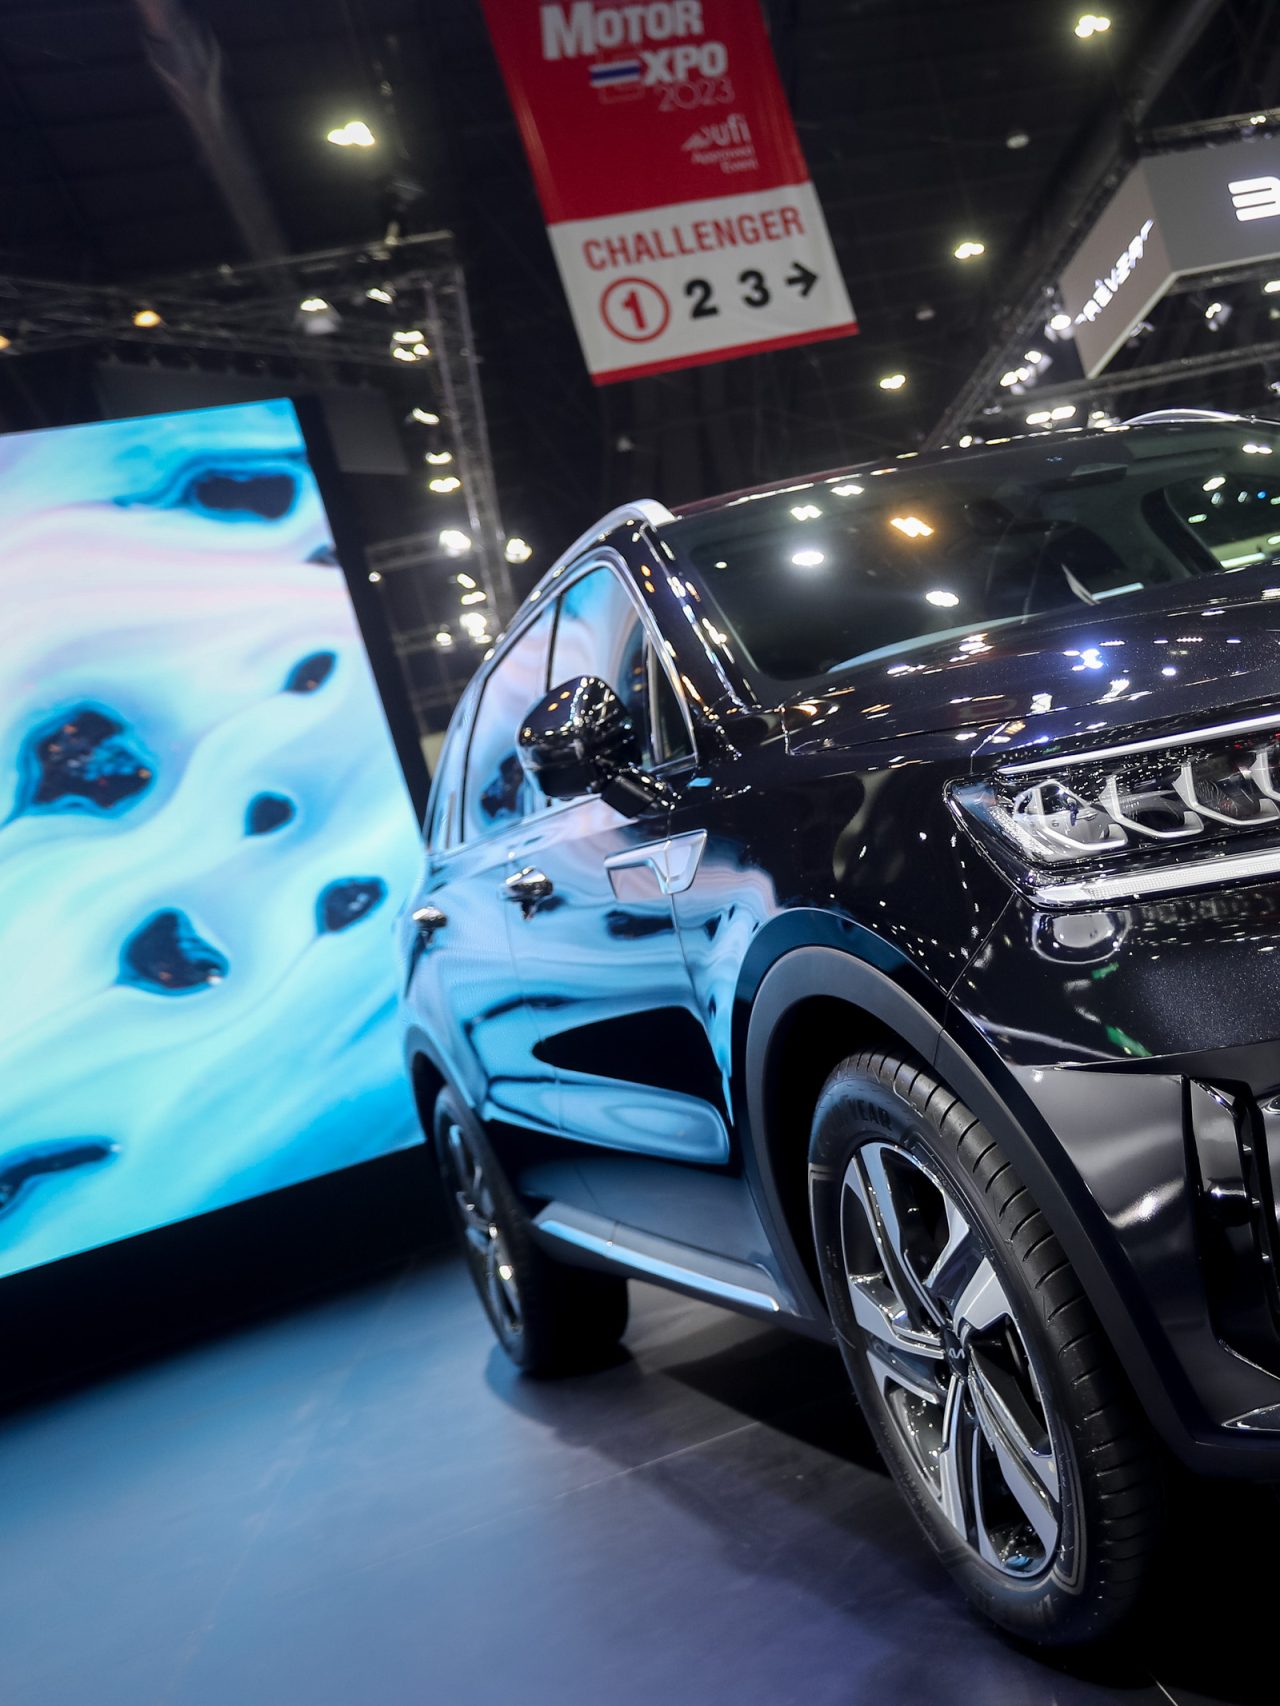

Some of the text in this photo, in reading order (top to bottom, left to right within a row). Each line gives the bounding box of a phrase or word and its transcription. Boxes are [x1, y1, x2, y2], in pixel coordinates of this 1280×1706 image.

[540, 0, 705, 60] MOTOR
[657, 77, 735, 112] 2023
[582, 205, 804, 272] CHALLENGER
[622, 269, 771, 331] 1 2 3
